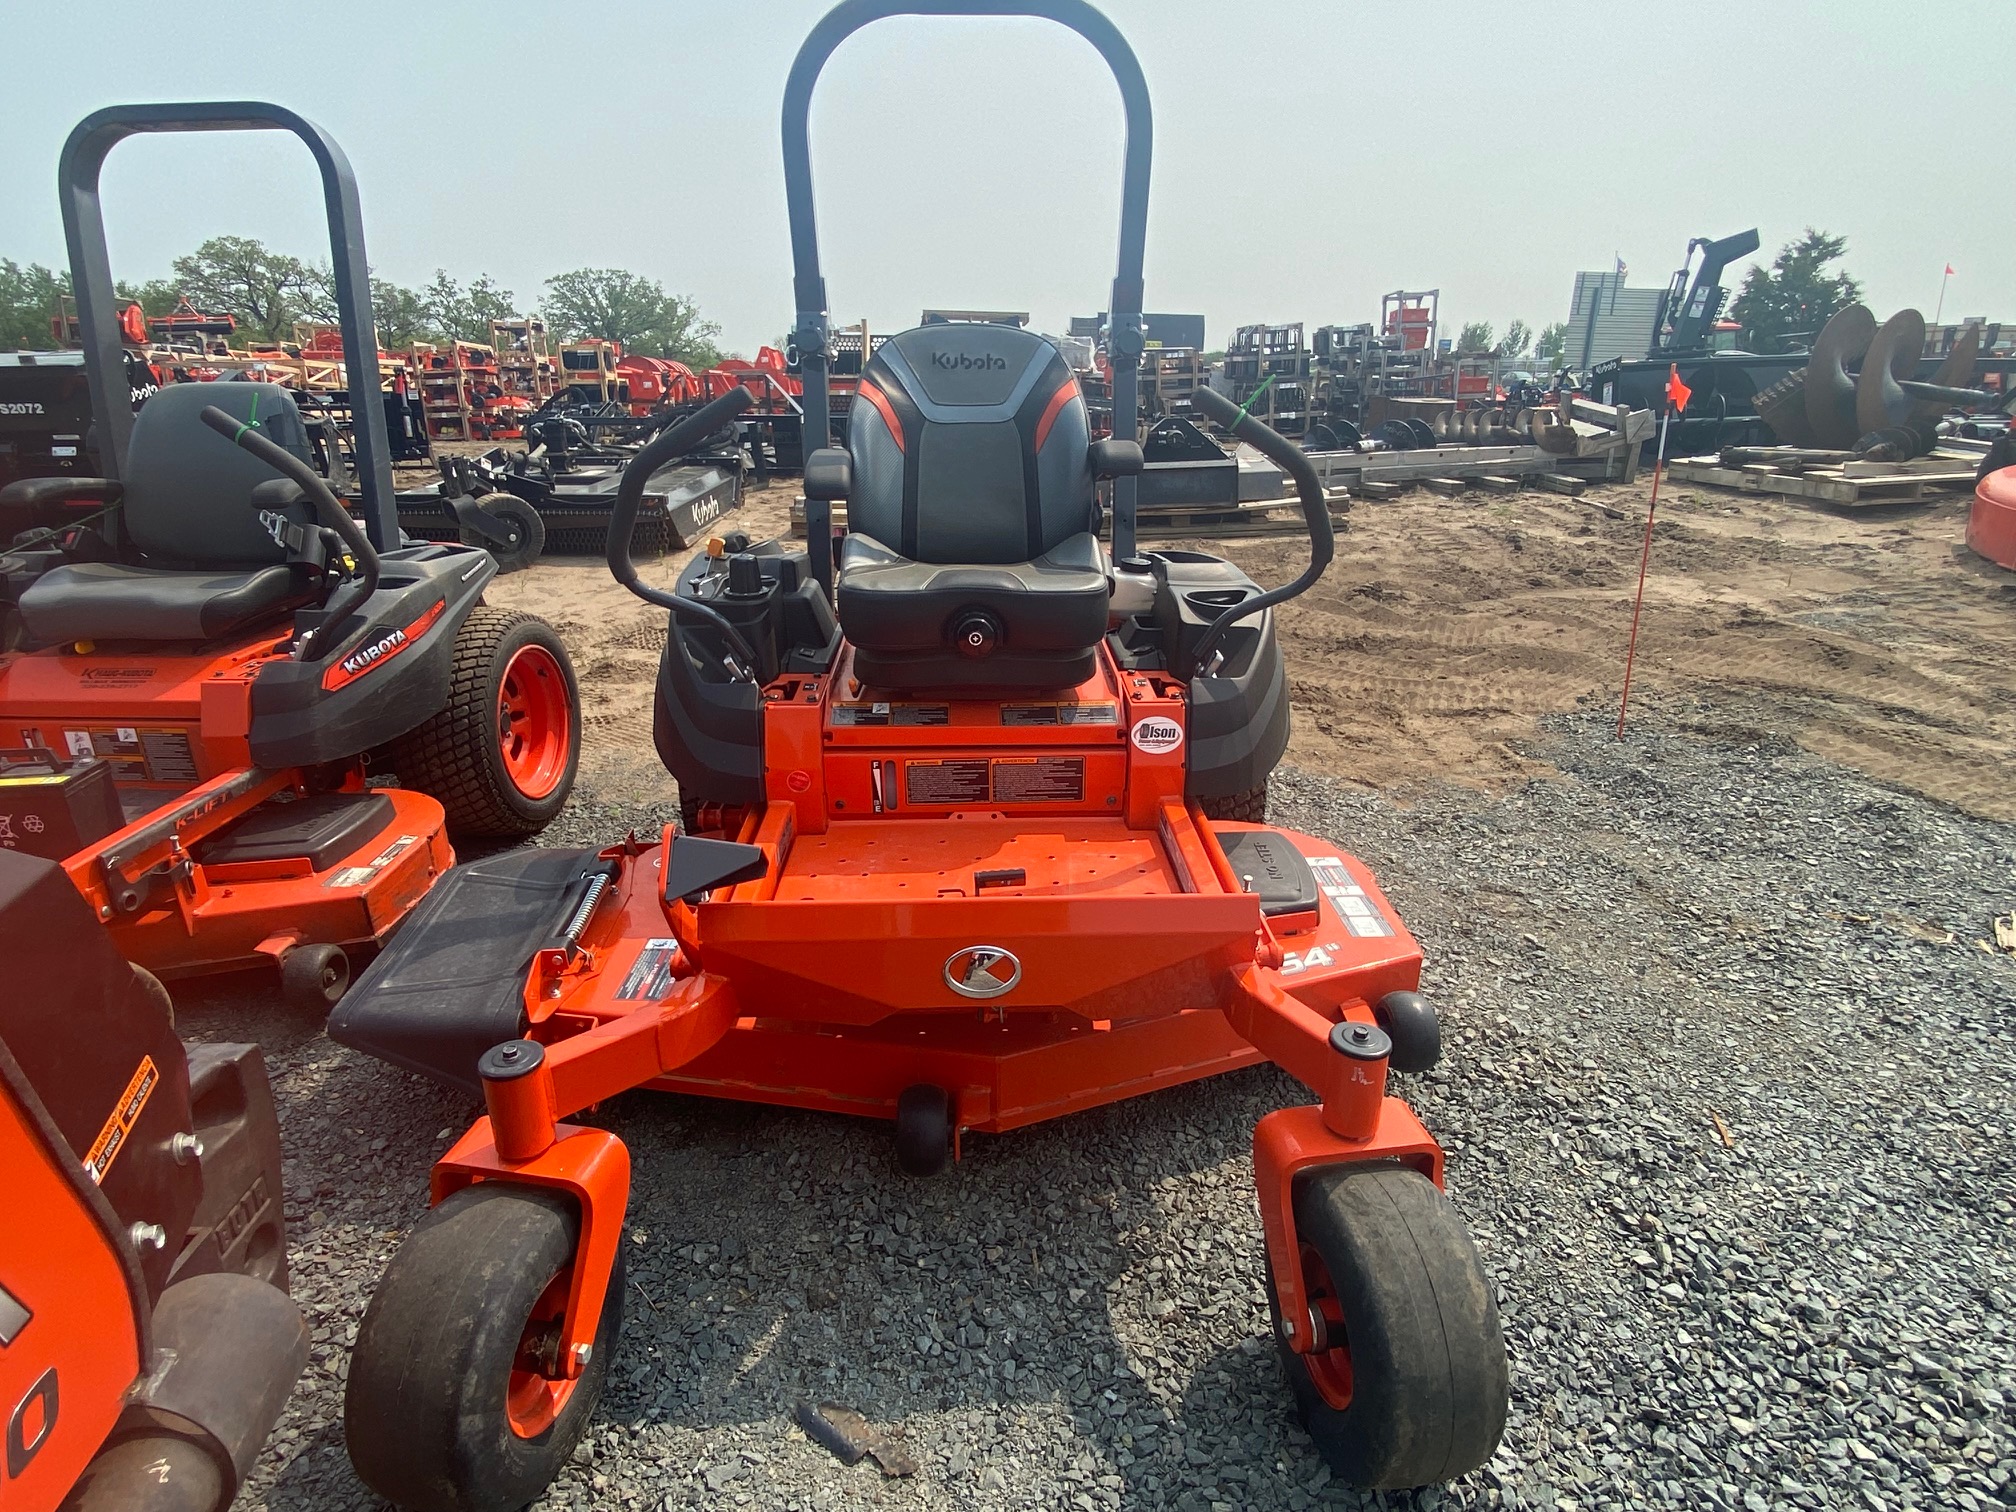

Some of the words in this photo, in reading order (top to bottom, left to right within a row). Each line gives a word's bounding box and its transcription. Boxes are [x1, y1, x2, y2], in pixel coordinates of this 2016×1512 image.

[932, 351, 1006, 371] Kubota
[131, 382, 159, 403] ubota
[692, 494, 720, 527] Kubota
[343, 630, 408, 675] KUBOTA
[1140, 723, 1177, 739] Olson
[873, 761, 879, 769] F
[1280, 943, 1341, 976] 54"
[92, 1115, 118, 1155] WARNING
[120, 1059, 152, 1112] ADVERTENCIA
[96, 1154, 107, 1171] HOT
